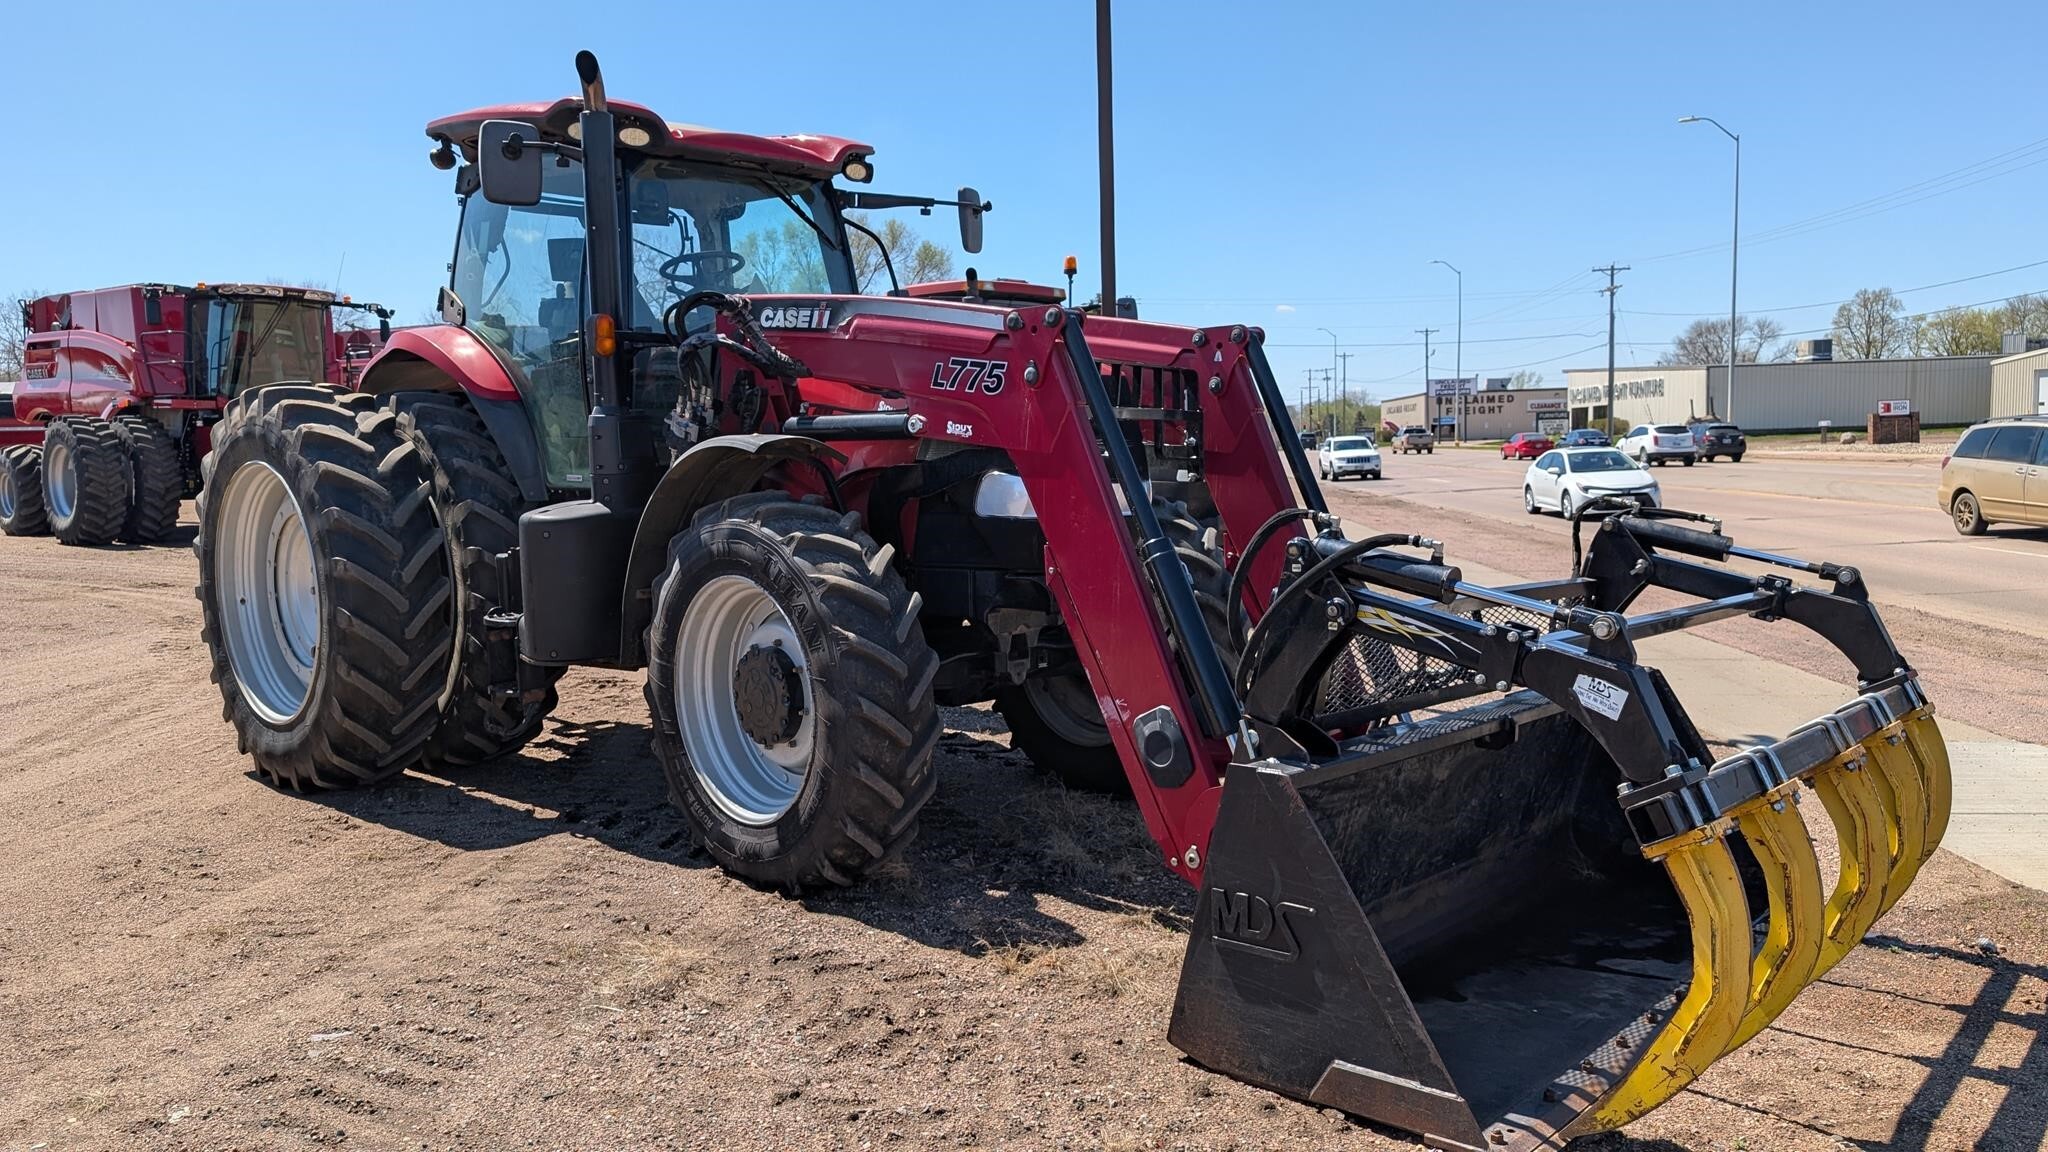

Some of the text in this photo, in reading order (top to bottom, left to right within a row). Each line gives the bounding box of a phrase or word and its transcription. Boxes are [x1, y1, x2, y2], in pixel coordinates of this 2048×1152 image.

[760, 307, 811, 328] CASE
[930, 357, 1008, 395] L775
[1587, 678, 1619, 698] MDS
[1211, 887, 1317, 961] MDS
